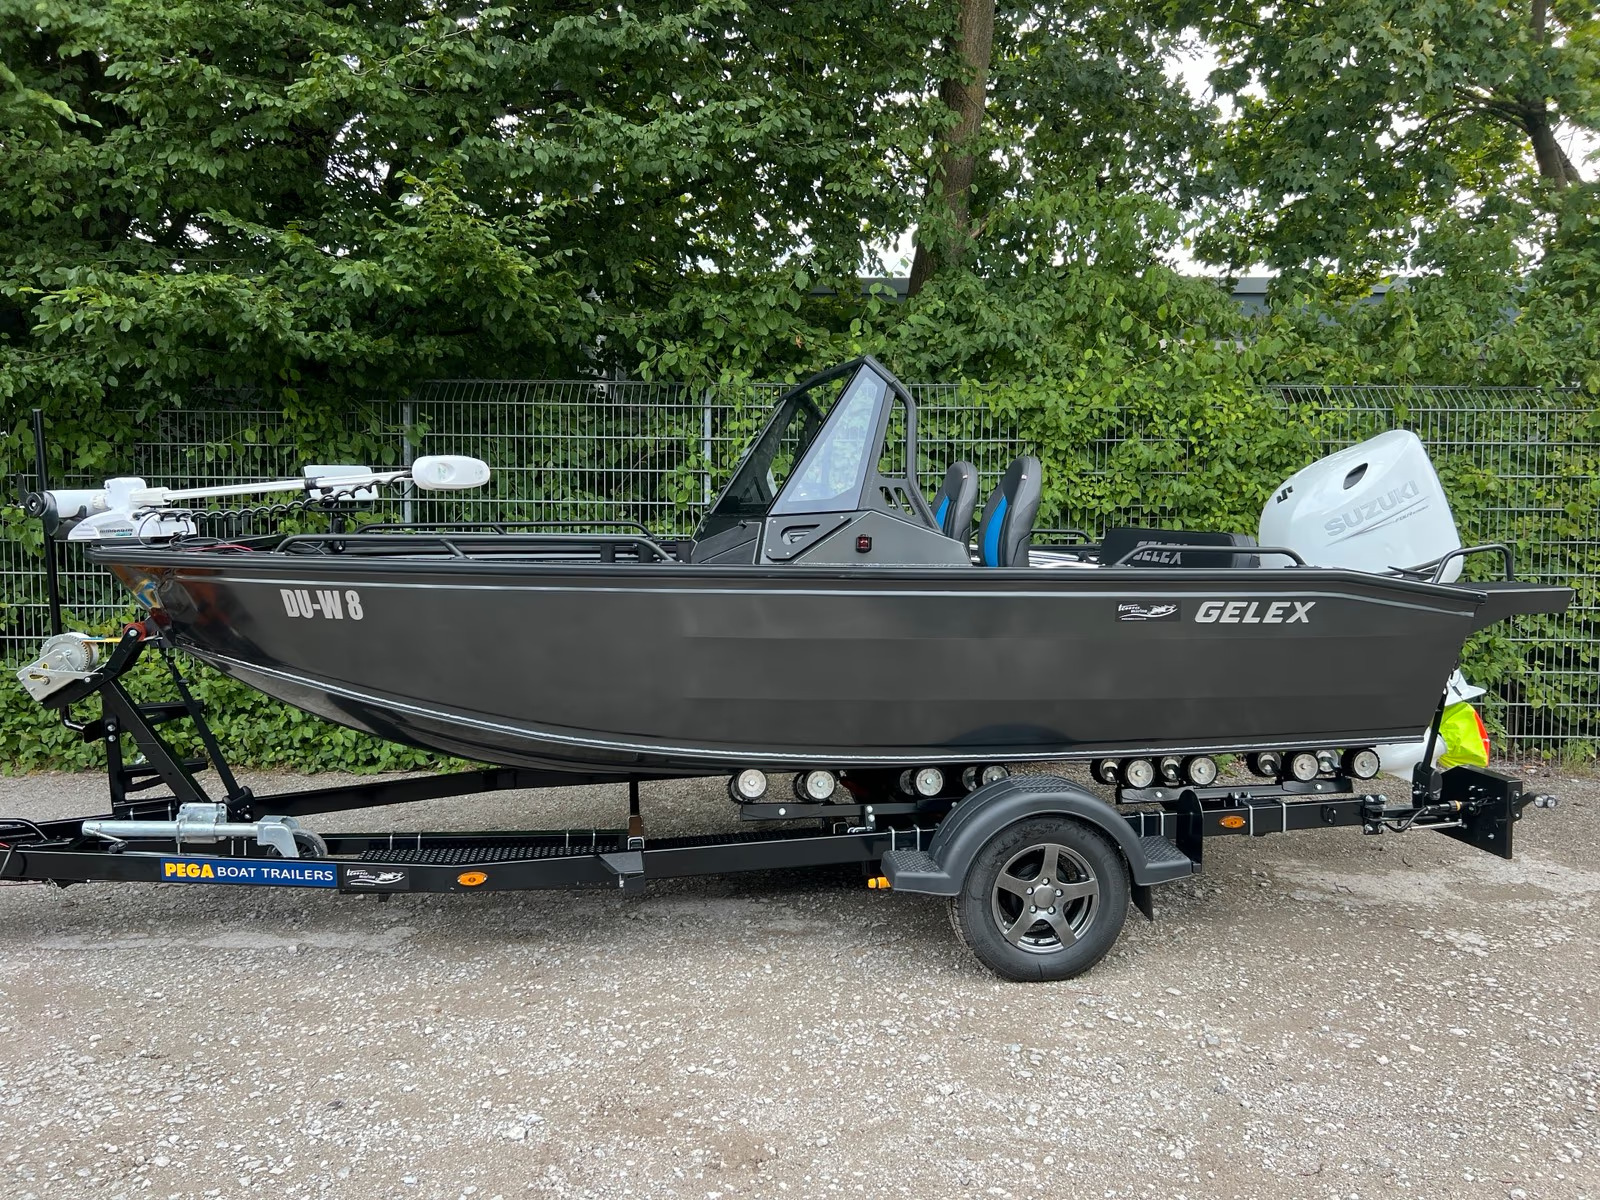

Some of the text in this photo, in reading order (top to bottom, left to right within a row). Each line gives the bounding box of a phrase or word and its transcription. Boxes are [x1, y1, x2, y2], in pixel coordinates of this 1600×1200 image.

[1324, 480, 1420, 537] SUZUKI
[279, 588, 364, 621] DU-W 8
[1194, 601, 1317, 624] GELEX
[164, 862, 215, 879] PEGA
[217, 866, 257, 878] BOAT
[261, 868, 334, 881] TRAILERS
